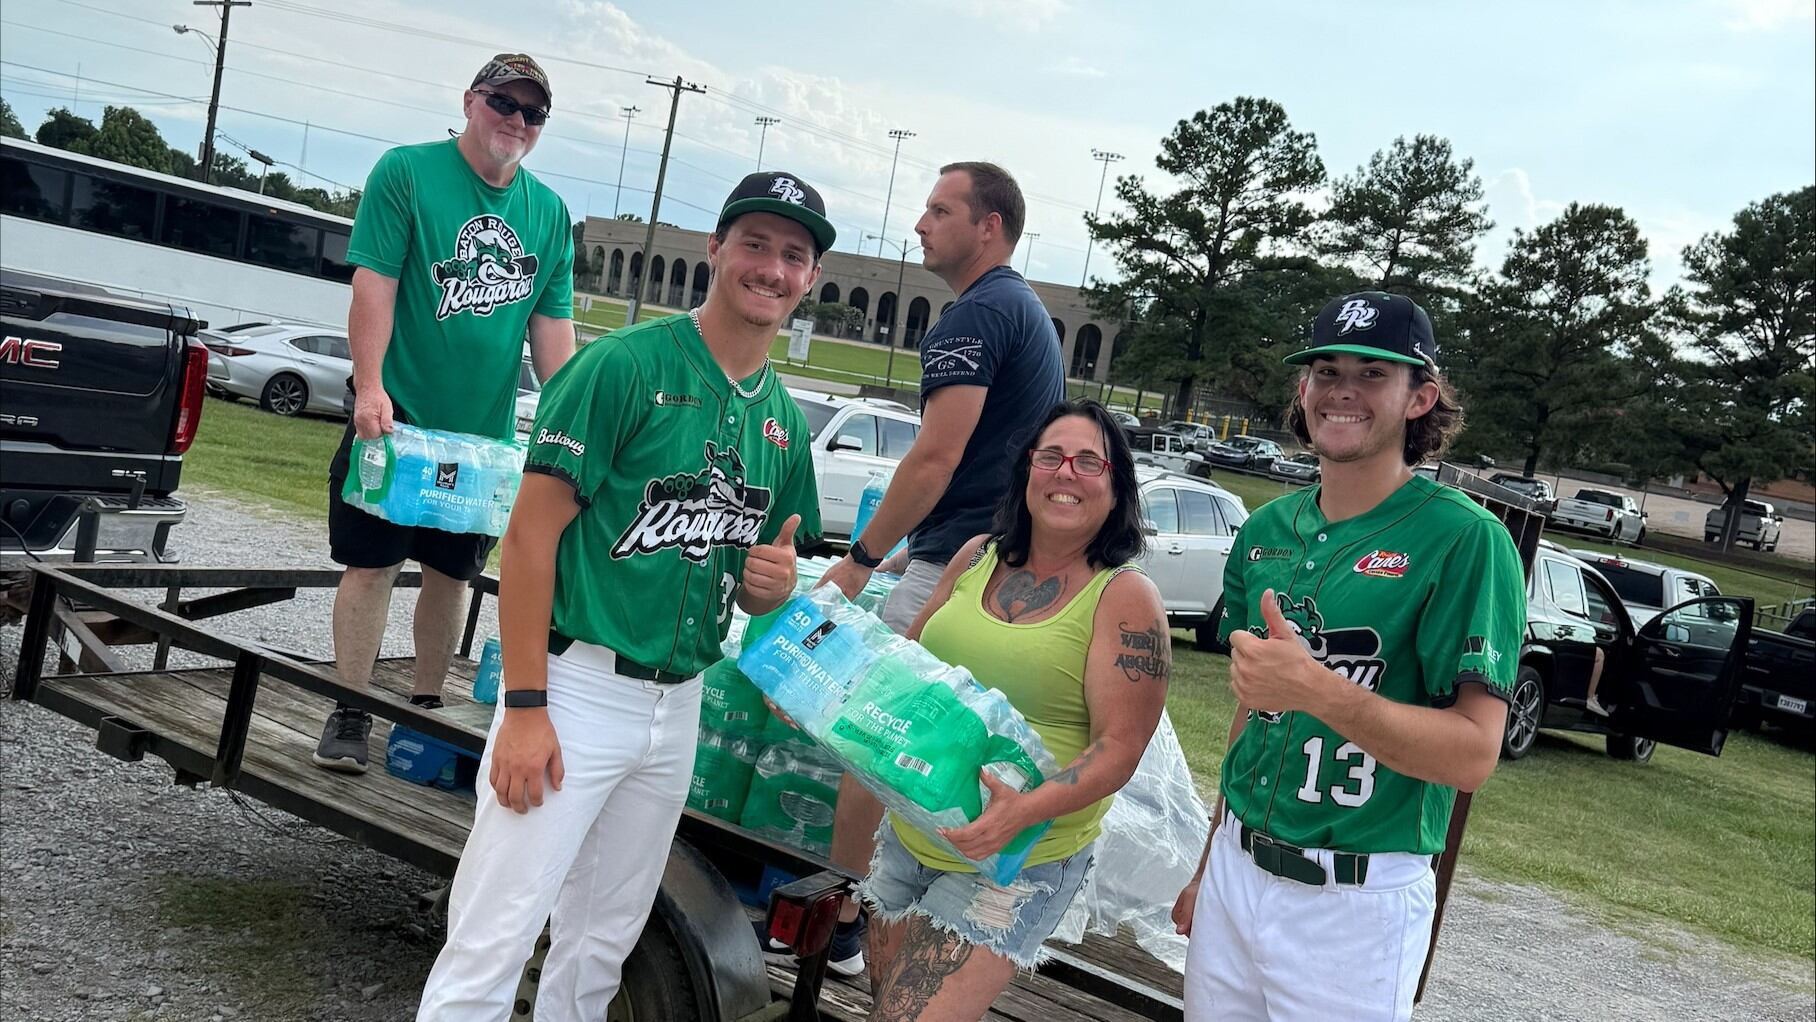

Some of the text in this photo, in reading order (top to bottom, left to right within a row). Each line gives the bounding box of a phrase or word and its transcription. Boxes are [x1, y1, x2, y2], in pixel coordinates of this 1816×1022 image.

[459, 218, 524, 259] BATON ROUGE
[955, 336, 983, 345] STYLE
[937, 358, 956, 371] GS
[421, 465, 433, 476] 40
[419, 488, 496, 509] PURIFIED WATER
[793, 610, 812, 627] 40
[772, 649, 793, 665] FOR
[807, 660, 847, 700] WATER
[846, 706, 866, 723] FOR
[865, 719, 885, 735] THE
[861, 701, 913, 736] RECYCLE
[1297, 736, 1377, 808] 13
